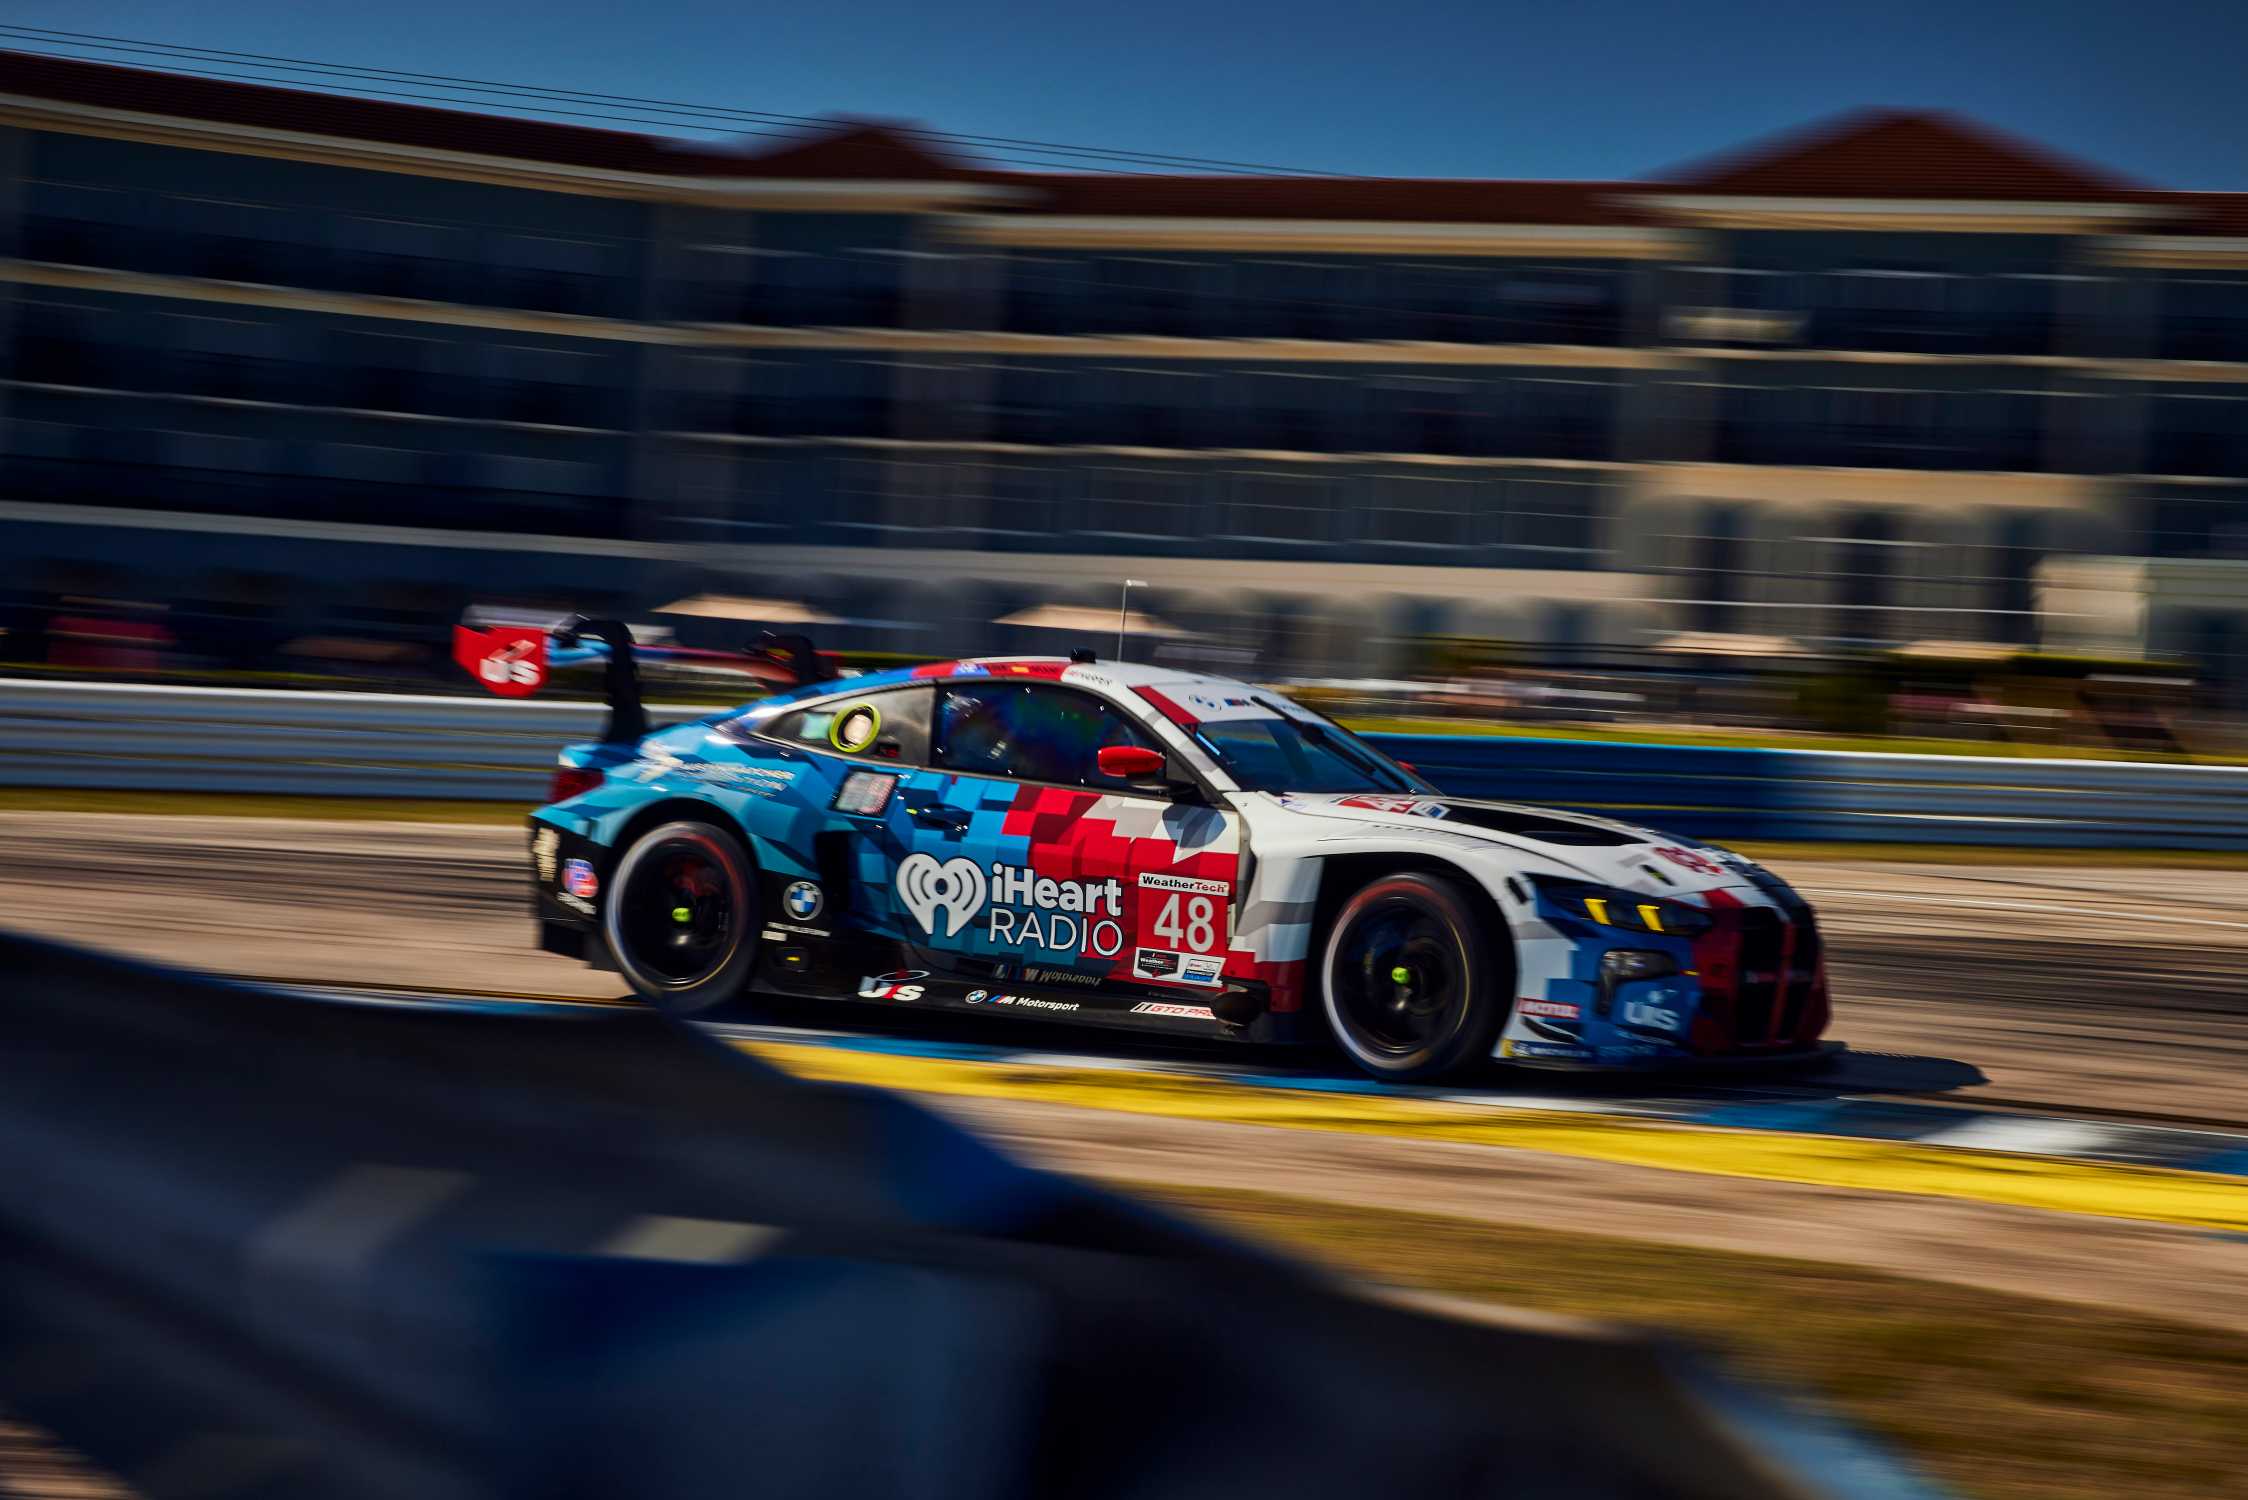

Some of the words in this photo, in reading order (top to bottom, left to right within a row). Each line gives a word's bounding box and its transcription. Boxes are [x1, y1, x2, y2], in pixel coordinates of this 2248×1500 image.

[992, 863, 1122, 917] iHeart
[1142, 875, 1227, 894] WeatherTech
[989, 907, 1123, 957] RADIO
[1153, 893, 1215, 953] 48
[1016, 997, 1080, 1011] Motorsport
